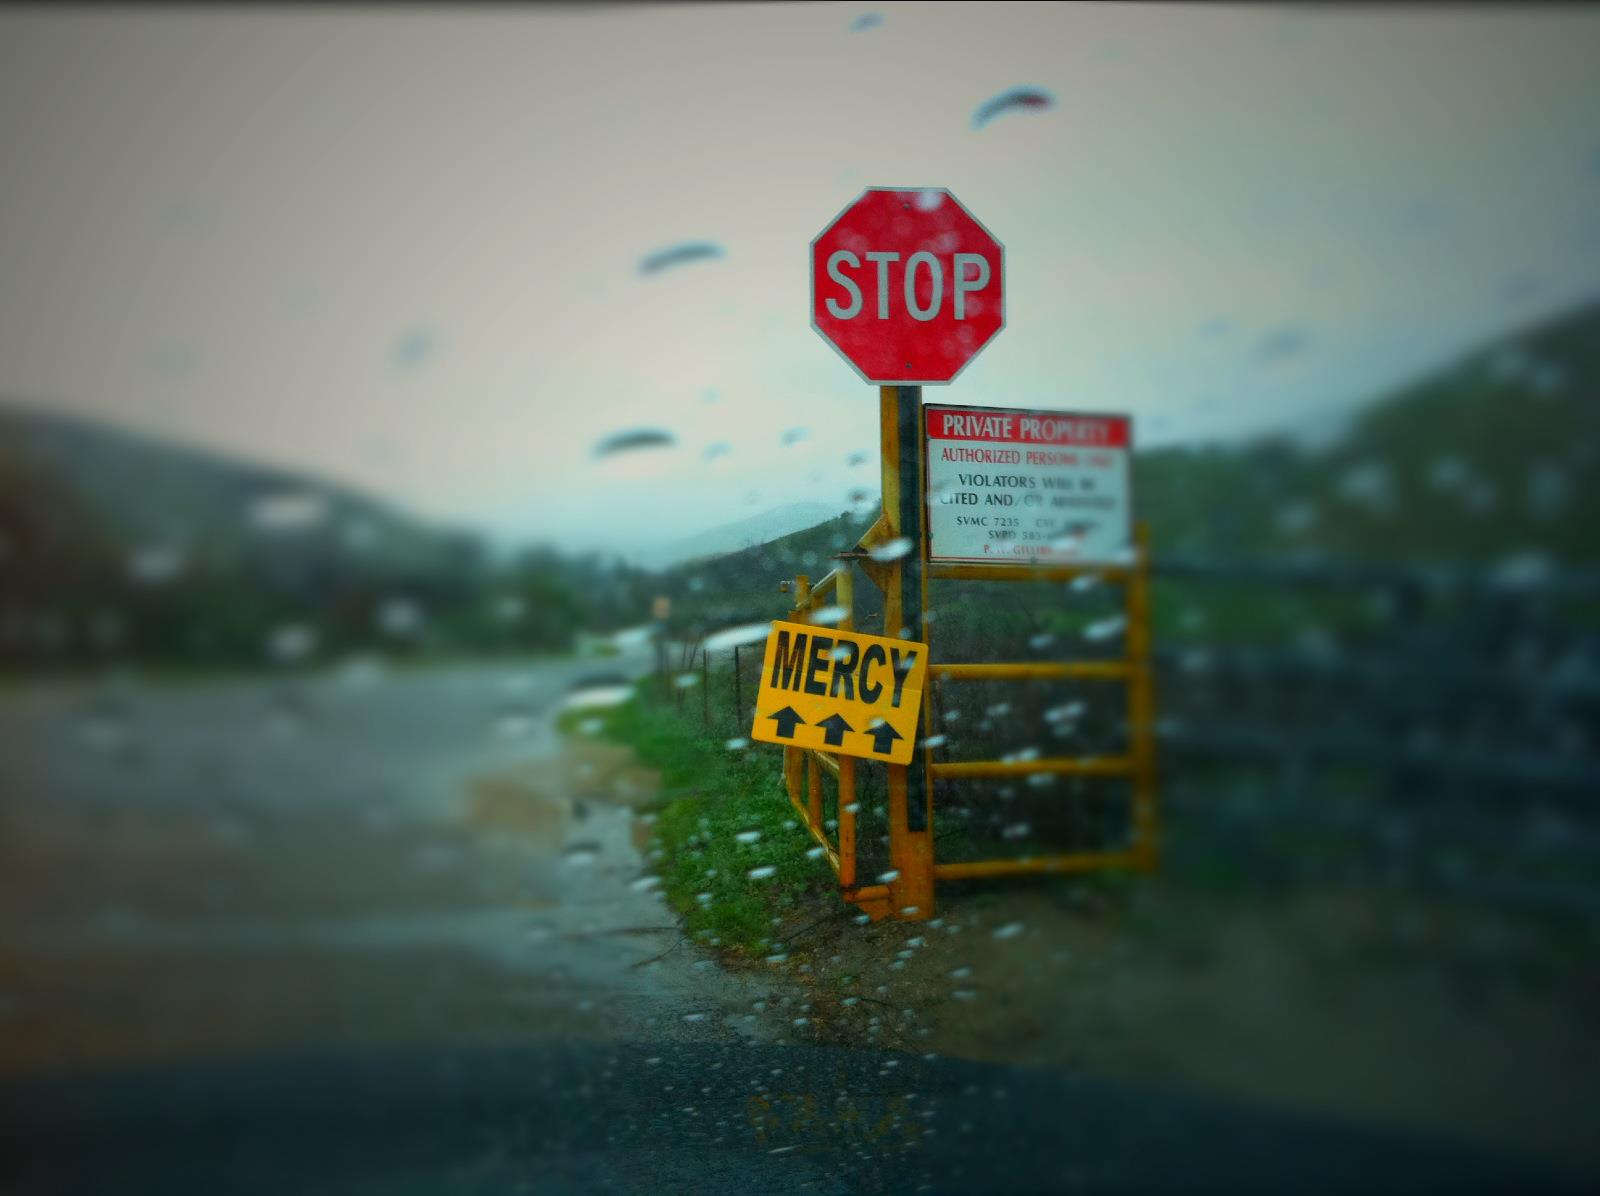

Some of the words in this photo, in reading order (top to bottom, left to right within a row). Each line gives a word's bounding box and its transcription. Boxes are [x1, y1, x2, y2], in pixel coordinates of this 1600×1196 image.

[825, 250, 991, 321] STOP
[942, 413, 1013, 438] PRIVATE
[941, 447, 1020, 465] AUTHORIZED
[1026, 451, 1078, 466] PERSO
[958, 473, 1036, 489] VIOLATORS
[956, 515, 989, 527] SVMC
[770, 630, 918, 708] MERCY
